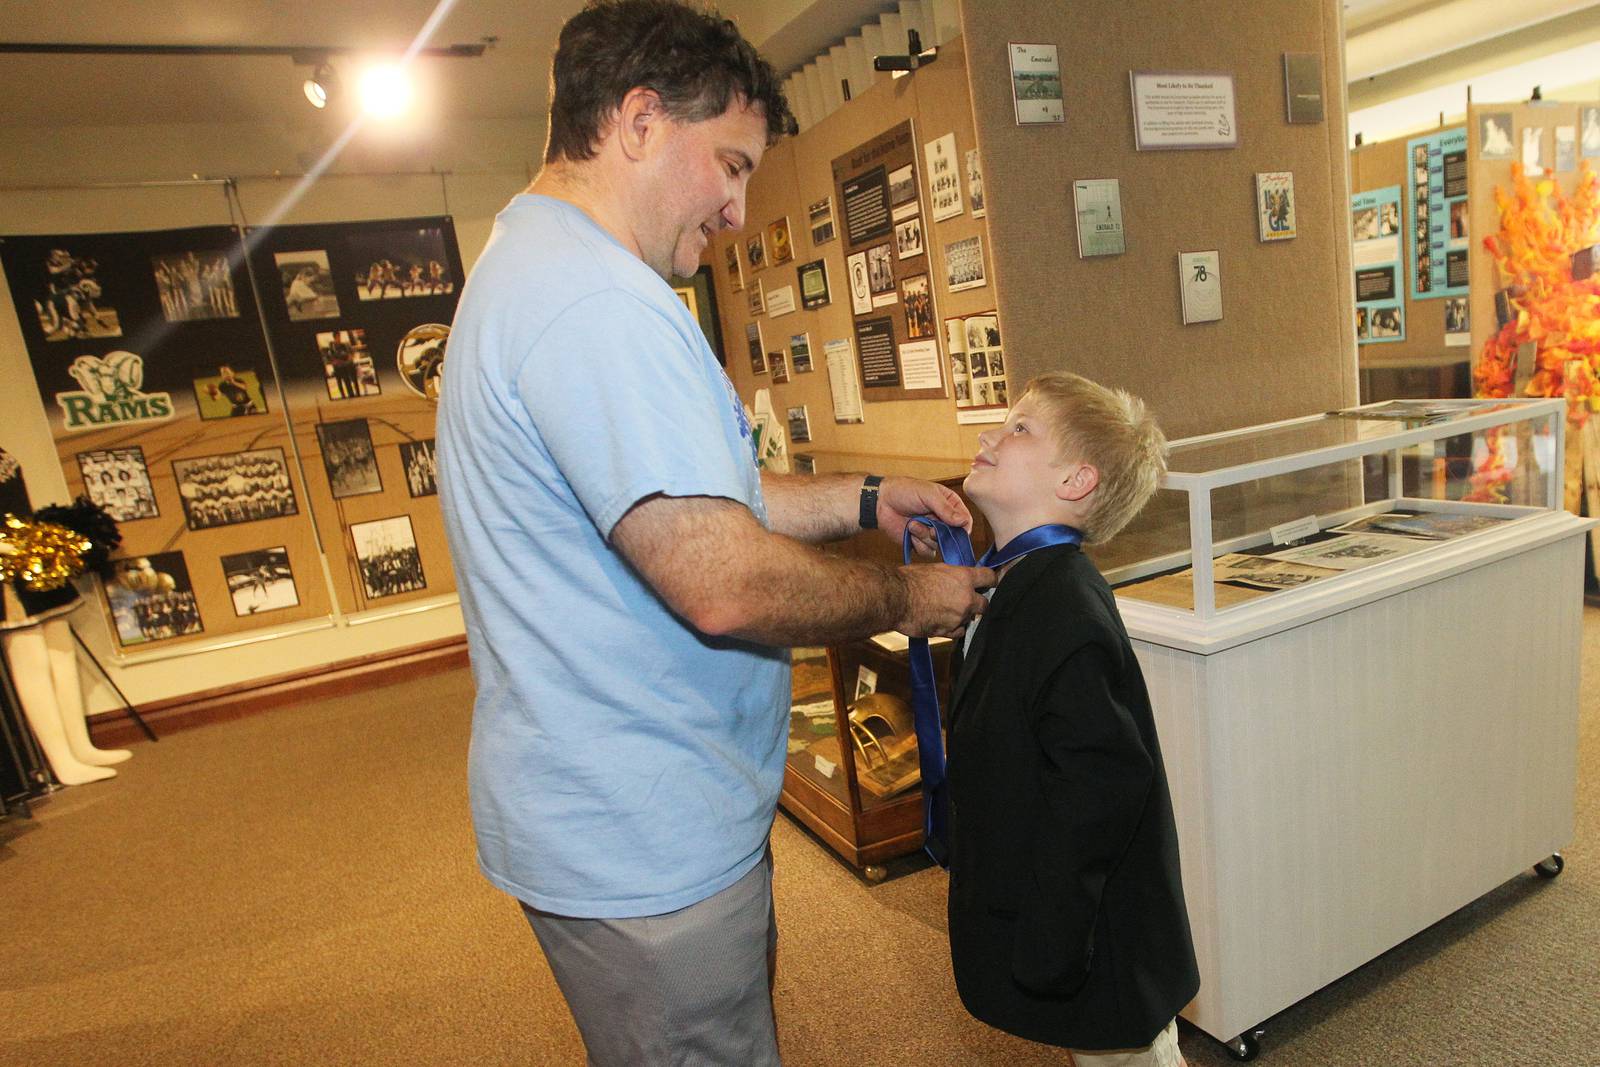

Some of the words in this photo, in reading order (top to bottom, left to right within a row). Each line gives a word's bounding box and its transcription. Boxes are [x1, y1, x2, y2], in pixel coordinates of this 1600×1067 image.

[1031, 55, 1052, 63] Emerald
[1194, 265, 1208, 282] 78
[63, 396, 170, 425] RAMS
